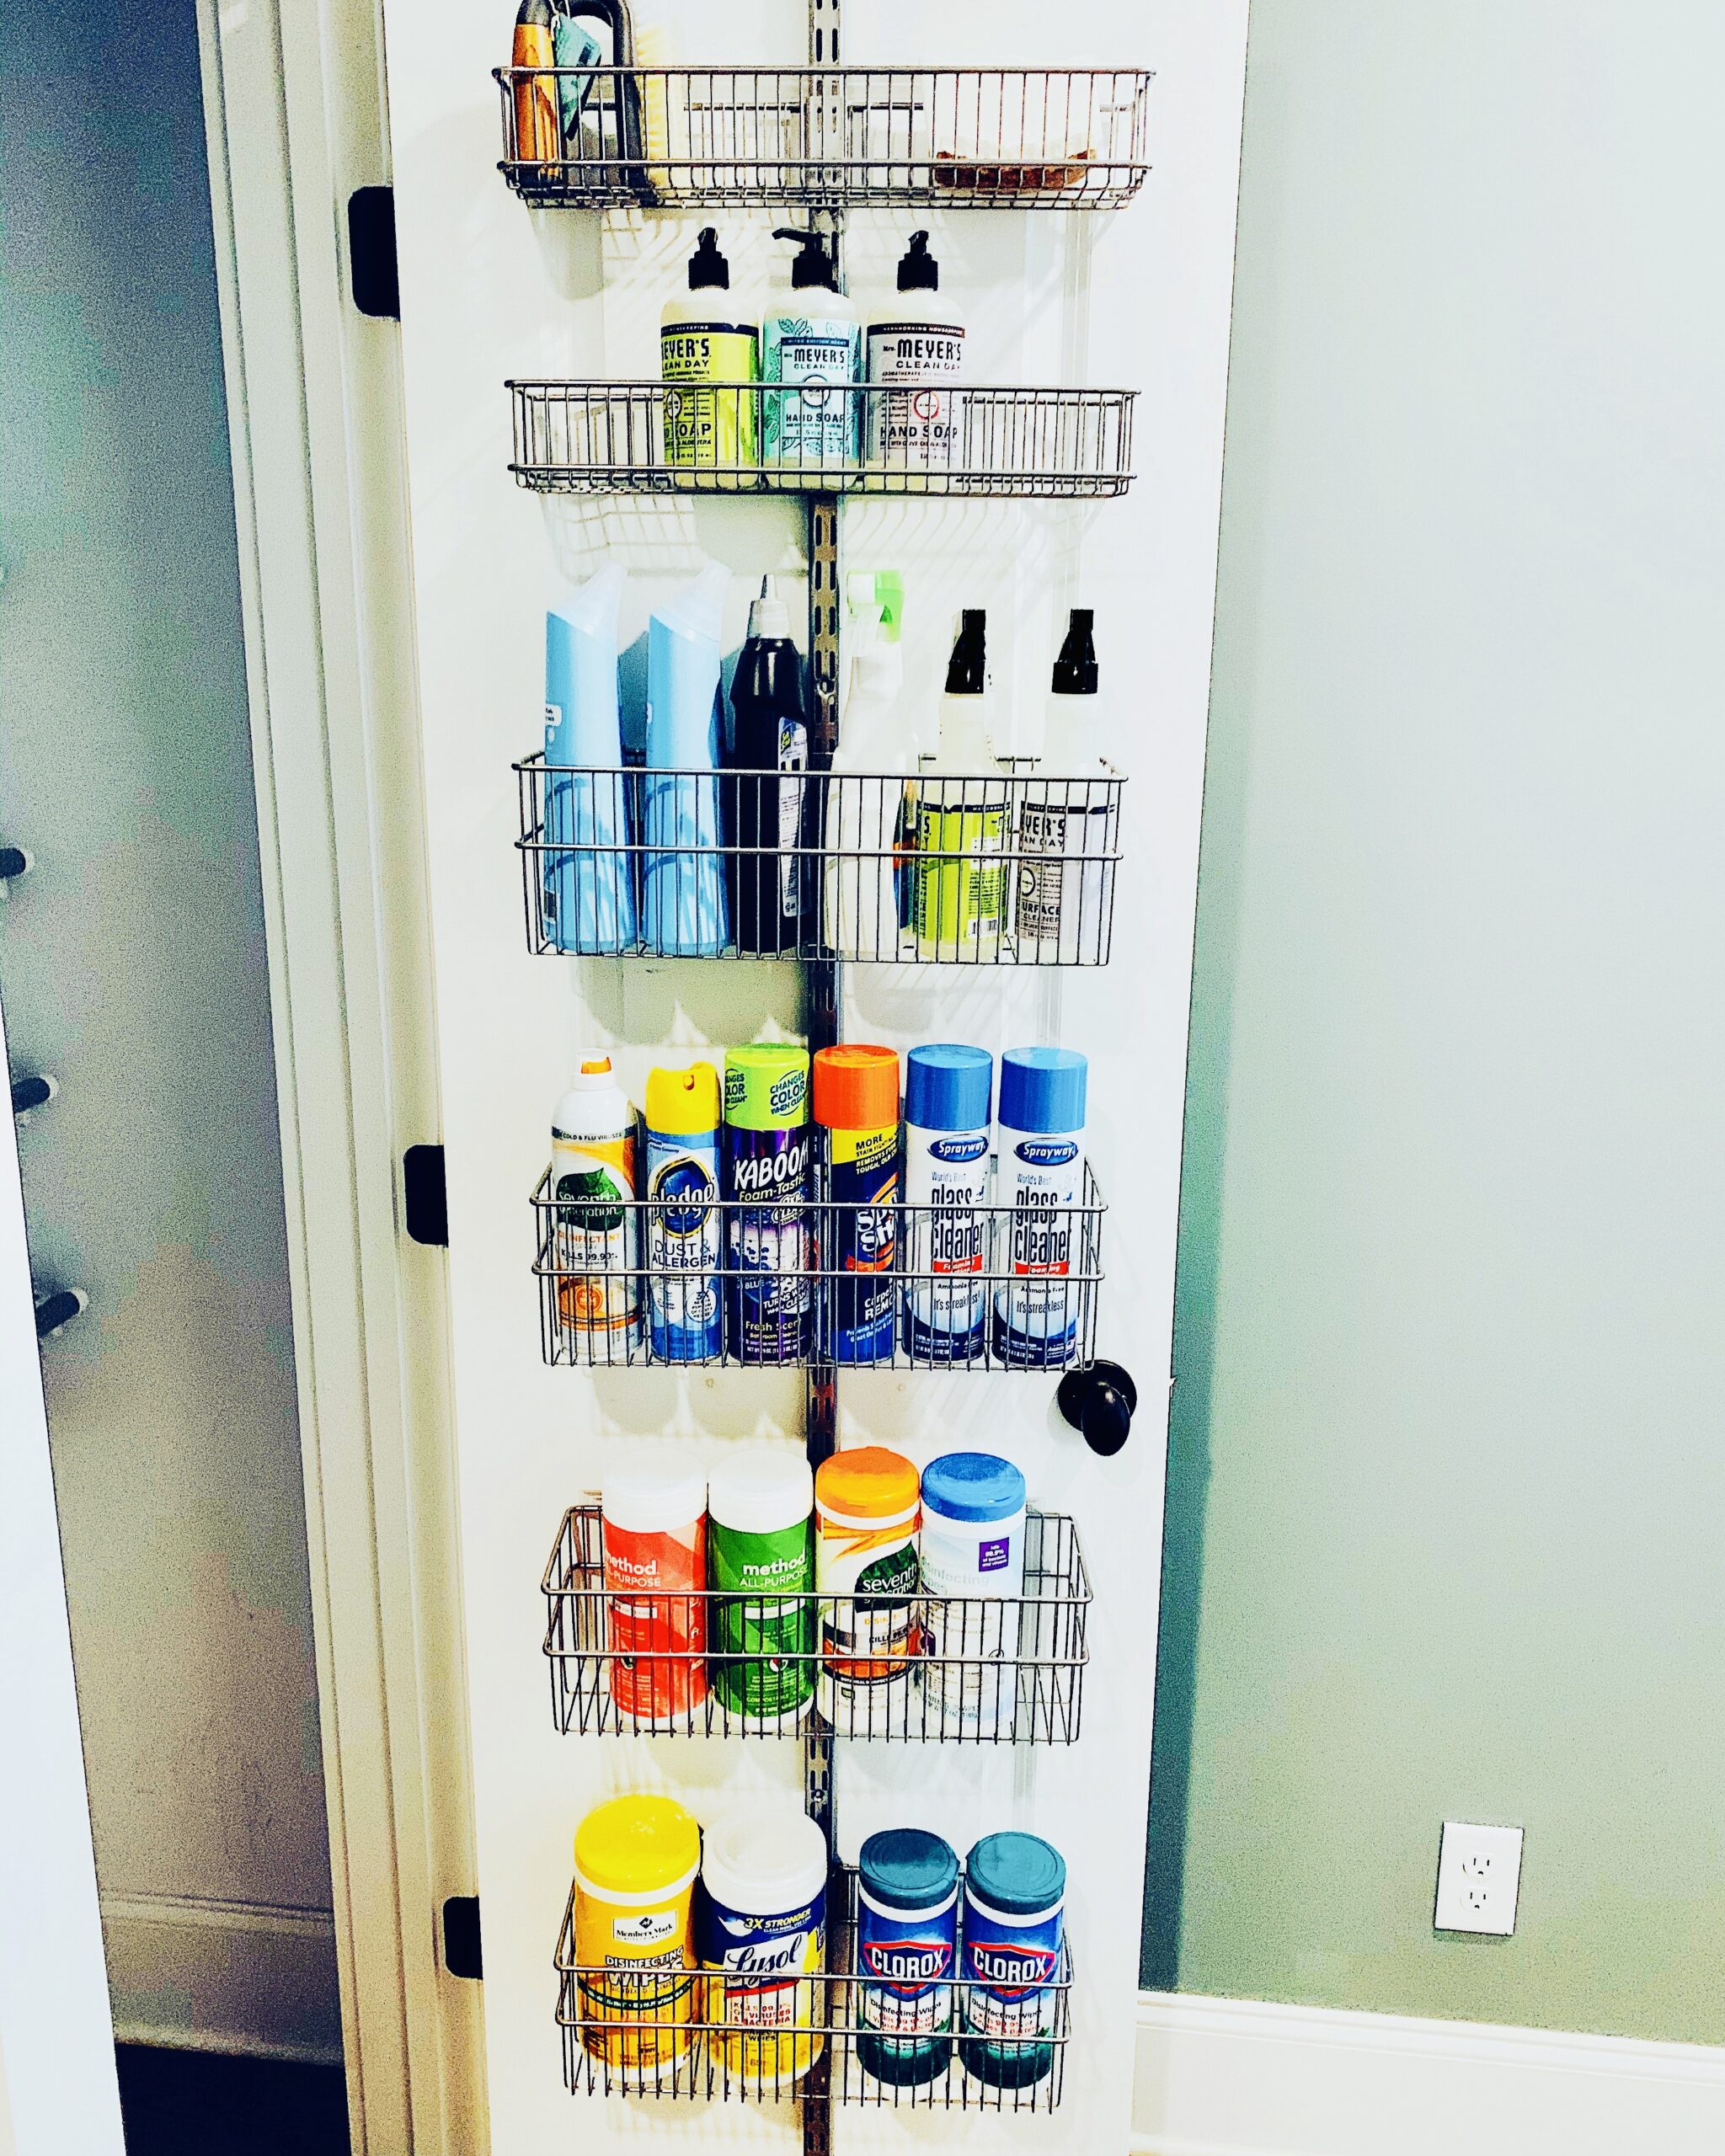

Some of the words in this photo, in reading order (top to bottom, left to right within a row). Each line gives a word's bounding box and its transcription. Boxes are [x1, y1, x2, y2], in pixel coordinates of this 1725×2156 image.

[661, 338, 709, 360] EYER'S
[897, 339, 961, 361] MEYER'S
[685, 360, 709, 368] DAY
[895, 360, 940, 369] CLEAN
[815, 413, 846, 423] SOAP
[674, 423, 712, 436] OAP
[880, 426, 918, 438] HAND
[922, 424, 958, 439] SOAP
[1024, 814, 1065, 837] YER'S
[1021, 901, 1061, 916] URFACE
[725, 1073, 745, 1084] ANGES
[770, 1070, 805, 1094] CHANGES
[725, 1083, 745, 1096] OLOR
[770, 1081, 805, 1107] COLOR
[771, 1102, 791, 1115] WHEN
[563, 1132, 578, 1140] COLD
[856, 1134, 884, 1150] MORE
[856, 1148, 873, 1158] STAIN
[938, 1140, 985, 1157] Sprayway
[1023, 1144, 1075, 1160] Sprayway
[734, 1135, 809, 1191] KABOOM
[856, 1151, 886, 1168] REMOVES
[931, 1183, 973, 1225] glass
[1016, 1186, 1058, 1227] glass
[654, 1240, 697, 1257] DUST
[700, 1239, 711, 1254] &
[932, 1221, 984, 1259] cleaner
[561, 1248, 583, 1261] KLLS
[652, 1252, 716, 1268] ALLERGEN
[1028, 1265, 1061, 1273] oaming
[1020, 1285, 1051, 1294] Amona
[1017, 1300, 1026, 1313] It's
[1027, 1299, 1064, 1314] streakless
[745, 1320, 772, 1331] Fresh
[850, 1332, 866, 1343] Geat
[742, 1548, 806, 1577] method
[868, 1634, 889, 1644] KILL
[744, 1918, 764, 1929] 3X
[764, 1908, 811, 1929] STRONGER
[605, 1945, 684, 1969] DISINFECTING
[727, 1934, 803, 1987] Lysol
[871, 1946, 944, 1978] CLOROX
[974, 1946, 1047, 1983] CLOROX
[607, 1956, 683, 1988] WIPES
[870, 1999, 917, 2017] Disnfecting
